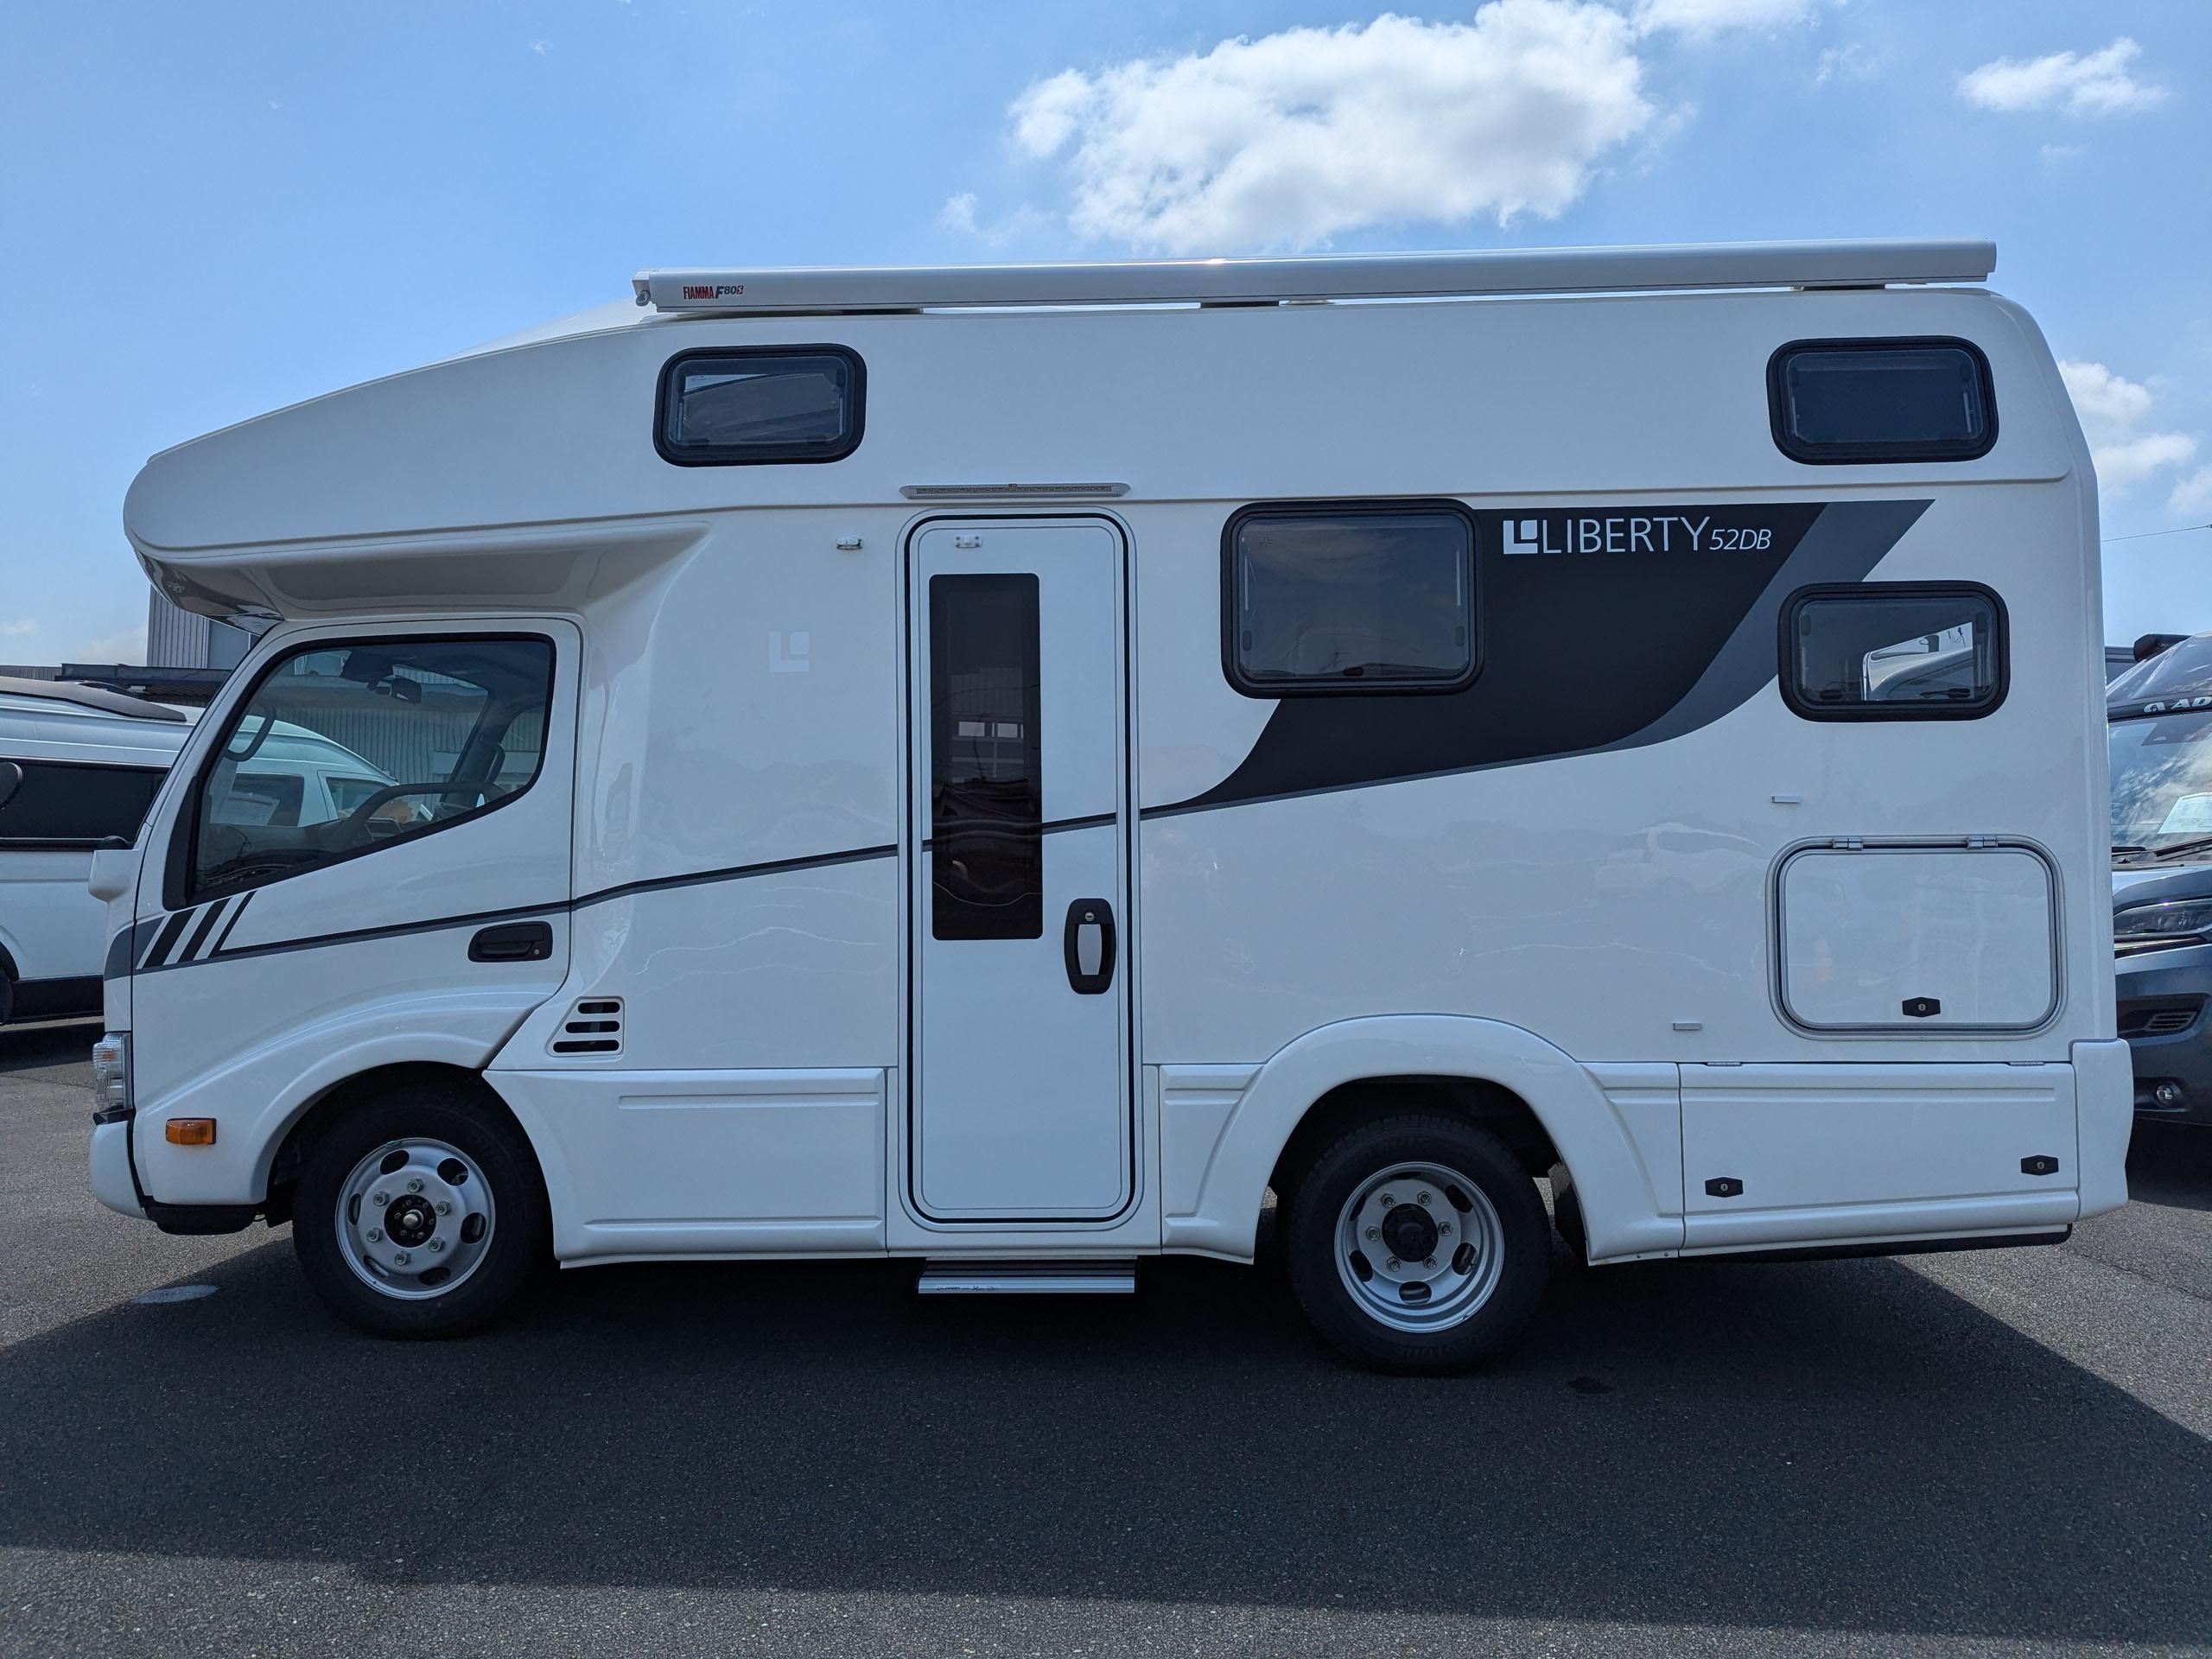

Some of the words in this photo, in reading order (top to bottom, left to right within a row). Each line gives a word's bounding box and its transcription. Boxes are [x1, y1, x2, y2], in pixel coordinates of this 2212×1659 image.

[683, 286, 715, 300] FIAMMA
[1542, 516, 1711, 554] LIBERTY
[1709, 528, 1772, 550] 52DB
